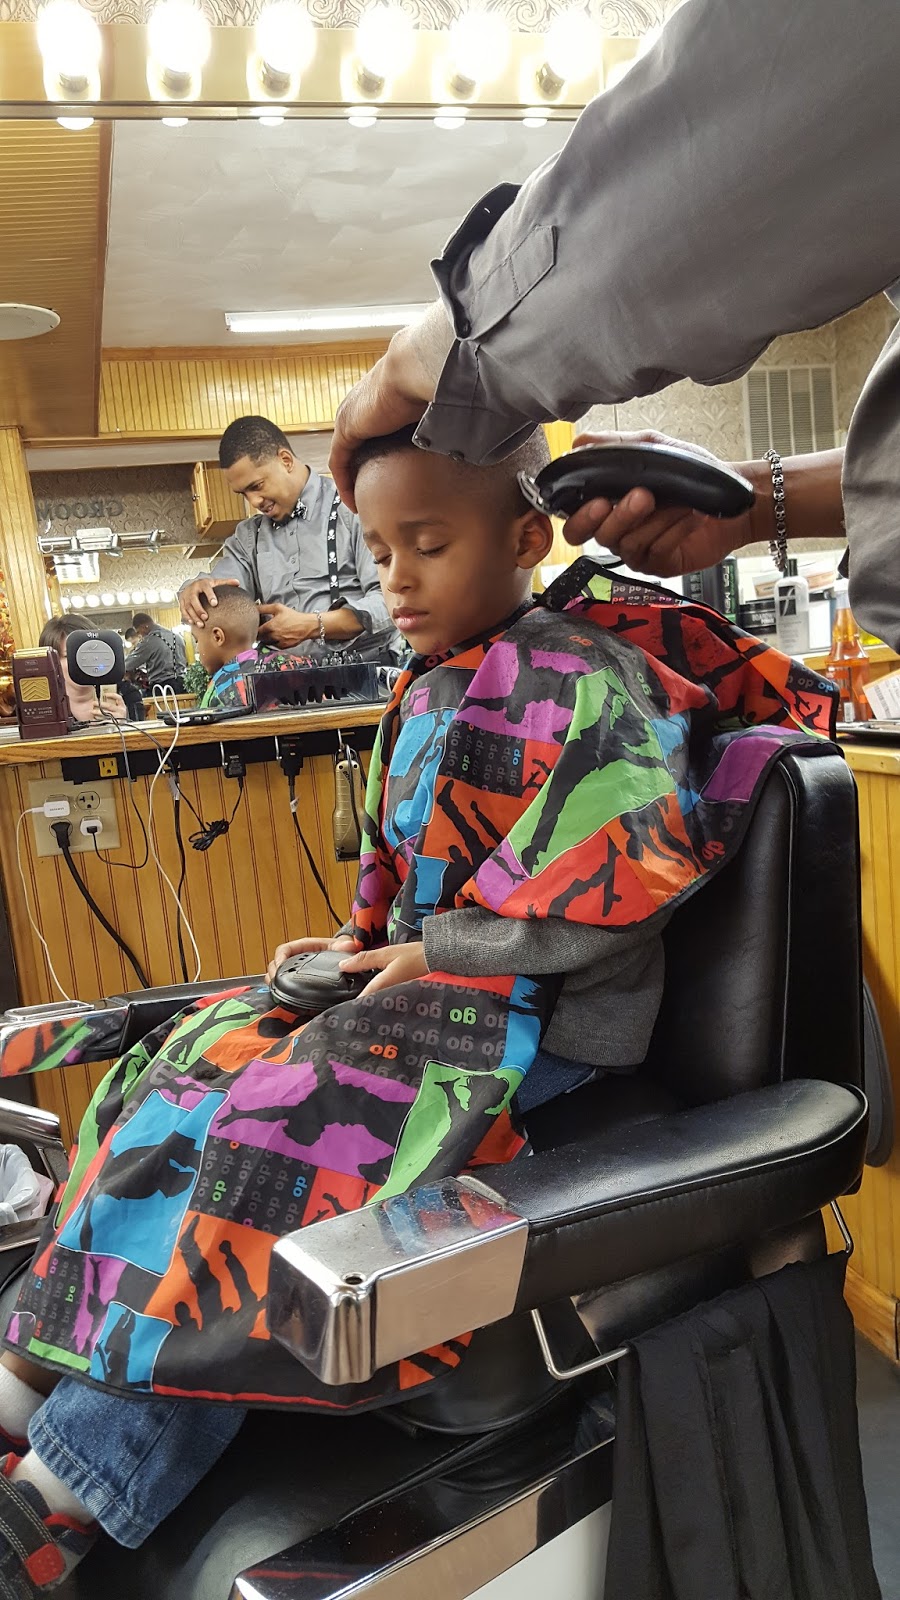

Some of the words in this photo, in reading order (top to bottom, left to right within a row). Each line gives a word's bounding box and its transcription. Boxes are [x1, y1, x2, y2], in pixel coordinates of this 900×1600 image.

[462, 754, 470, 771] do
[512, 749, 521, 765] do
[381, 995, 408, 1013] go
[449, 1006, 477, 1025] go
[343, 1016, 371, 1033] go
[377, 1022, 406, 1038] go
[412, 1028, 439, 1046] go
[446, 1035, 474, 1052] go
[369, 1044, 399, 1059] go
[212, 1180, 226, 1201] do
[293, 1176, 307, 1197] do
[65, 1285, 76, 1302] be
